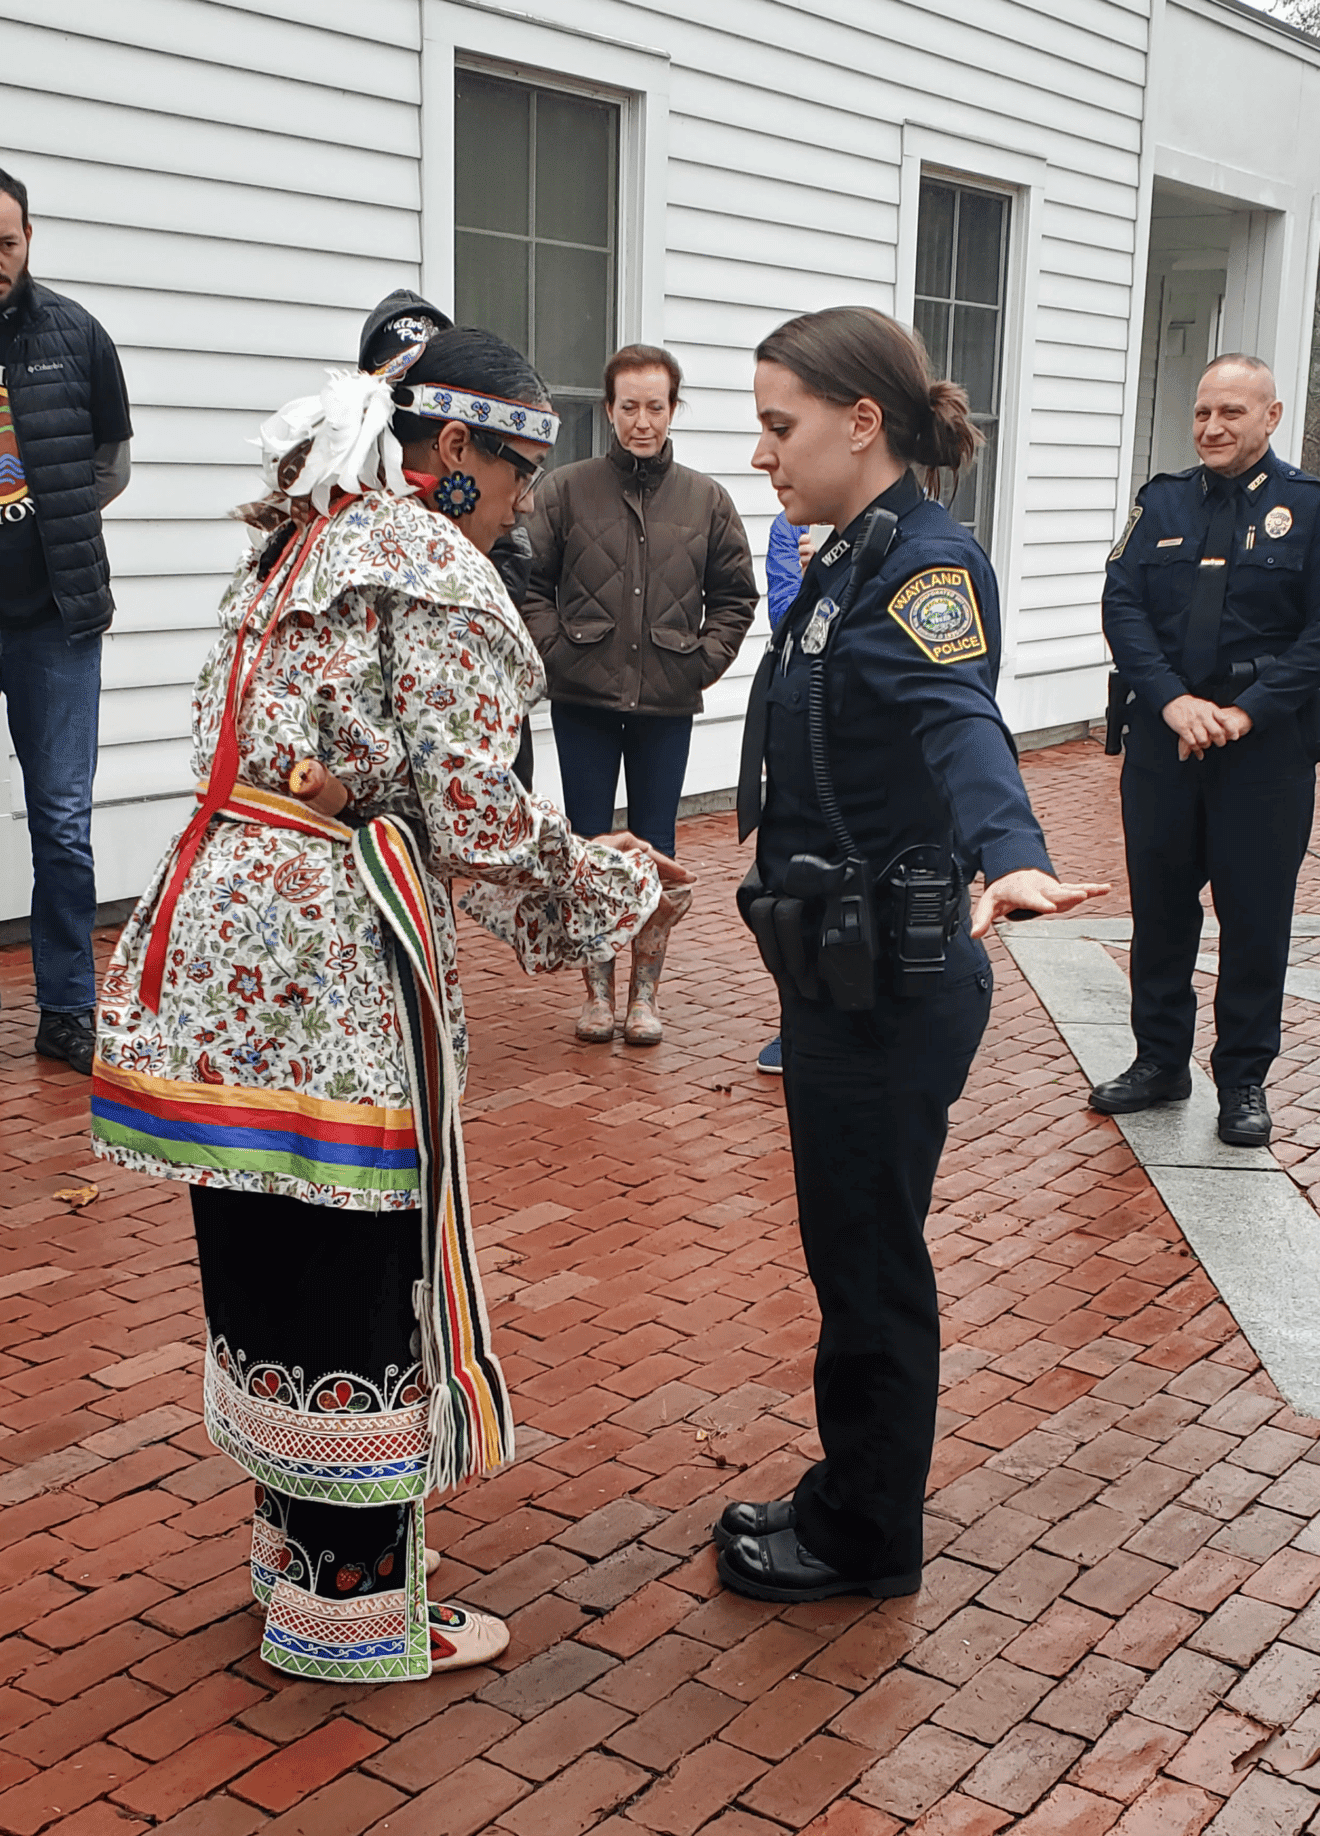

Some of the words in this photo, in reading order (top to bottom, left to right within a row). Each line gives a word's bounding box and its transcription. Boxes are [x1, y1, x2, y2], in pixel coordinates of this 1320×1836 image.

[34, 361, 64, 371] Columbia
[894, 572, 962, 610] WAYLAND
[932, 635, 981, 658] POLICE
